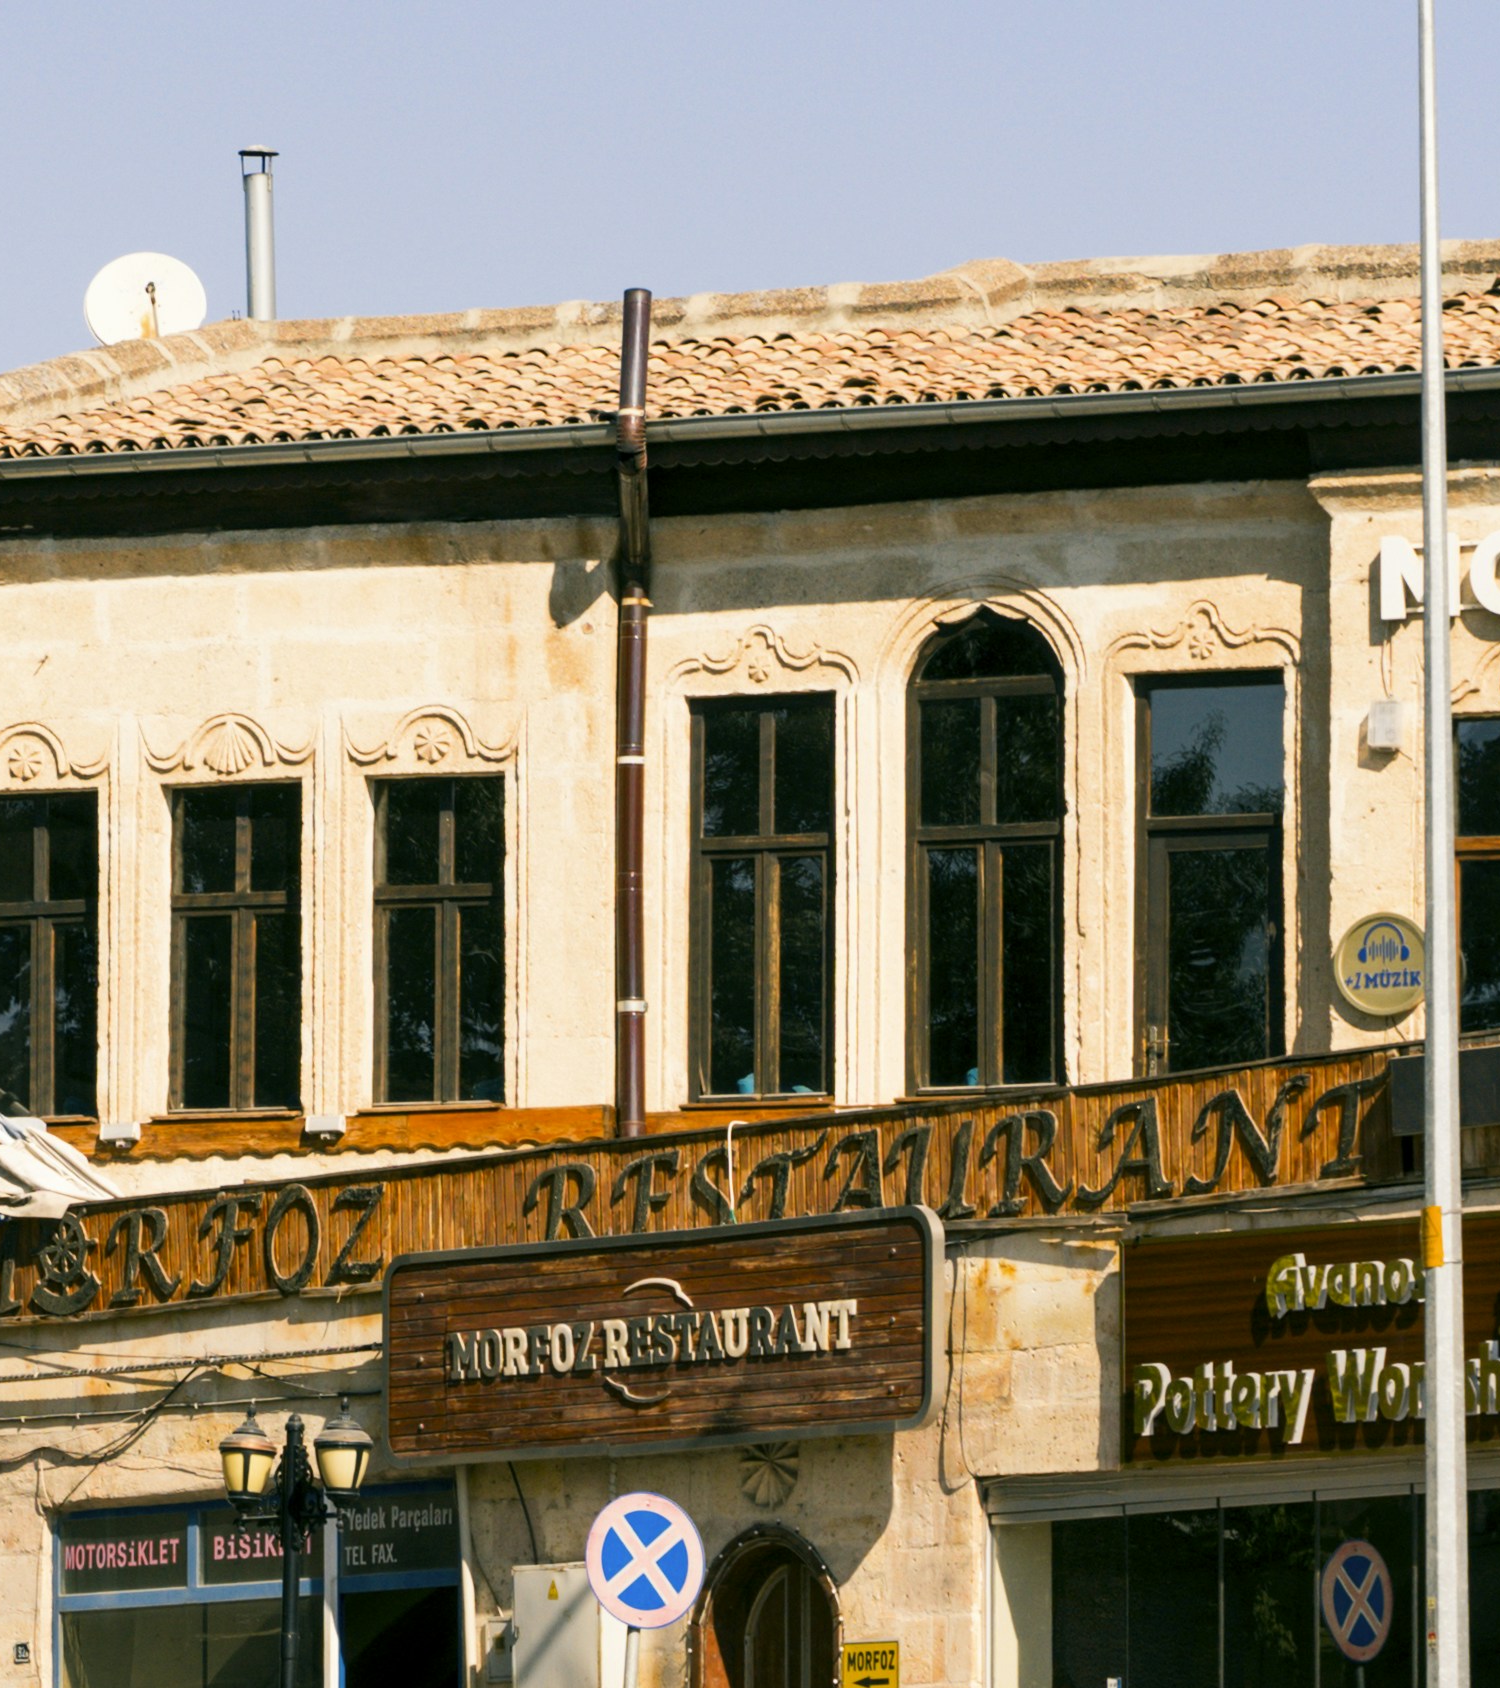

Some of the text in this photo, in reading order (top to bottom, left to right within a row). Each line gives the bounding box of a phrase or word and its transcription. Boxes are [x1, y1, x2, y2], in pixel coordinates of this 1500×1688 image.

[1364, 968, 1422, 989] MÜZİK
[527, 1066, 1390, 1238] RESTAURANT
[449, 1299, 858, 1381] MORFOZ RESTAURANT
[1133, 1359, 1316, 1446] Pottery
[348, 1502, 453, 1533] Yedek Parçaları
[344, 1545, 367, 1567] TEL
[846, 1649, 896, 1672] MORFOZ
